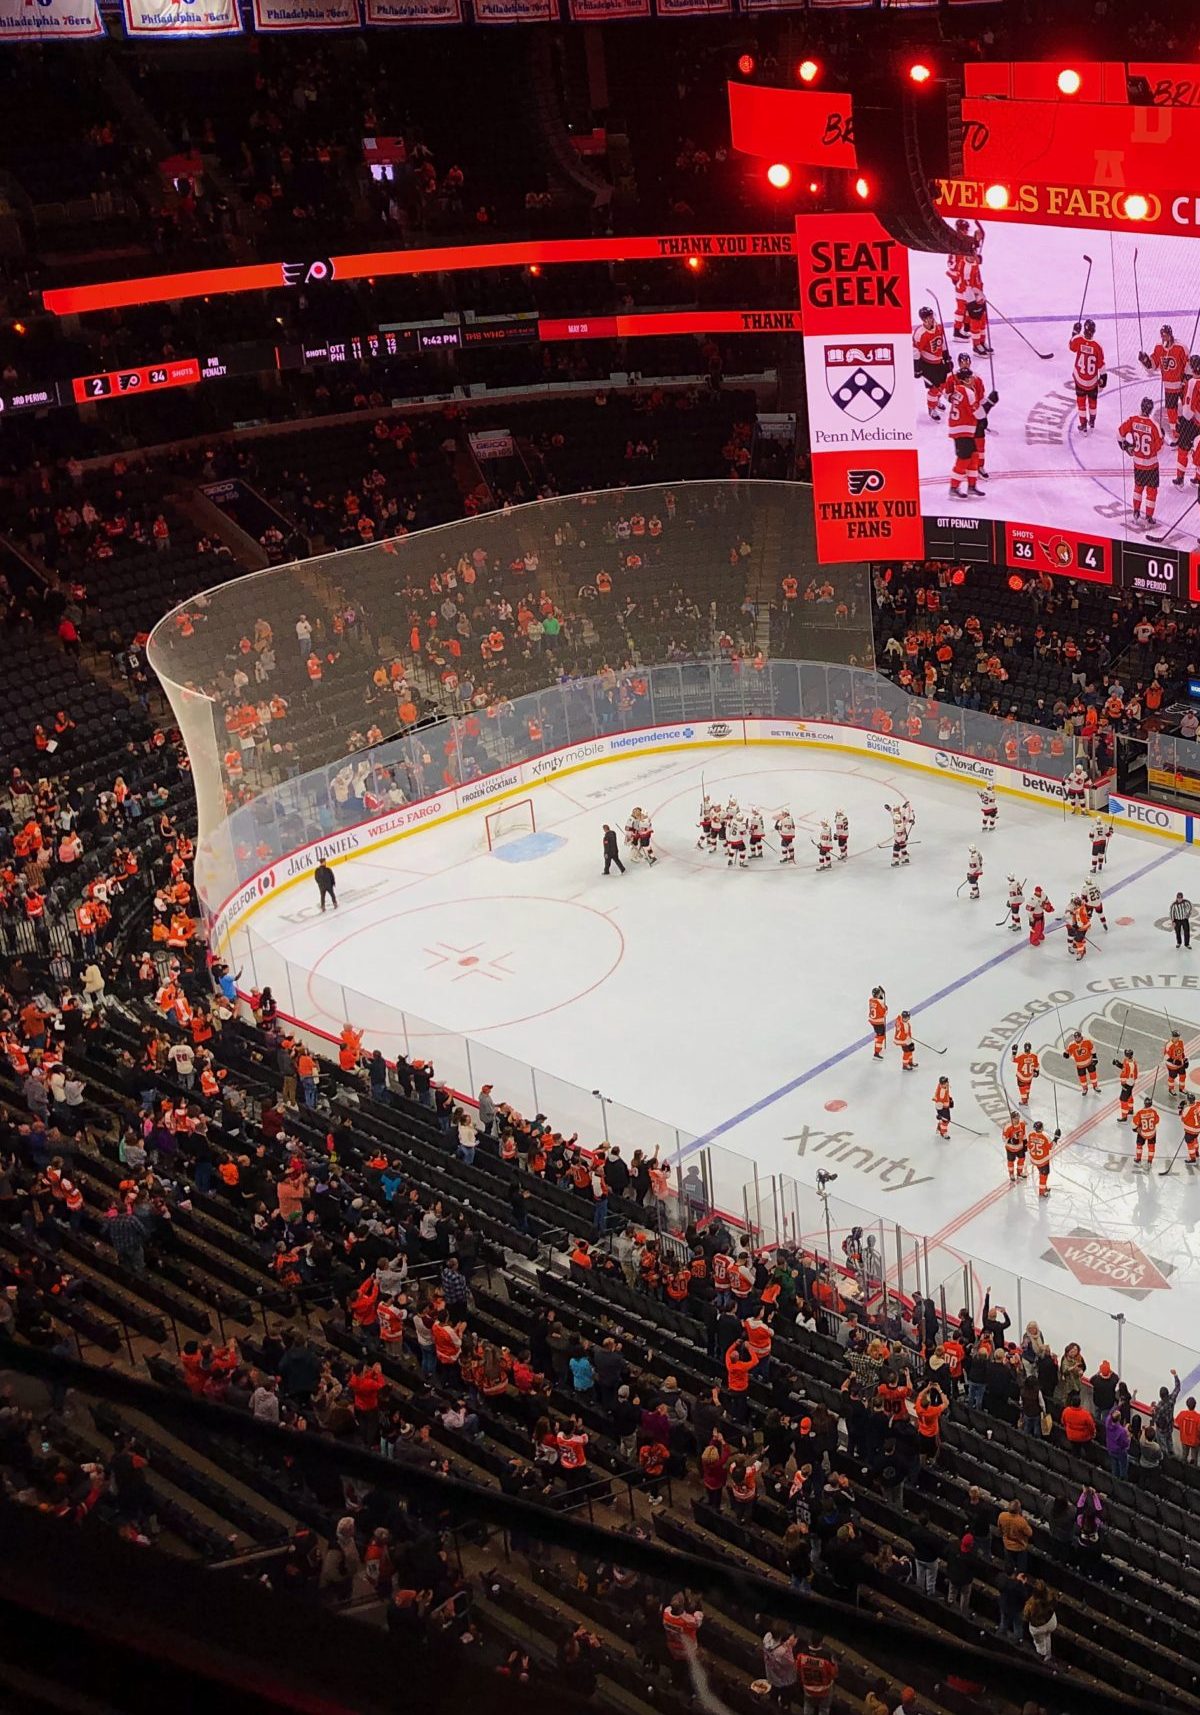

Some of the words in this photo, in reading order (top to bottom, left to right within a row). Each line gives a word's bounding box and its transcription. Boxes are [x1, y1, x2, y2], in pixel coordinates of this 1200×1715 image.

[0, 15, 60, 27] hiladelphia
[62, 15, 92, 26] 76ers
[141, 12, 201, 25] Philadelphia
[204, 12, 230, 22] 76ers
[266, 8, 325, 20] Philadelphia
[657, 238, 712, 256] THANK
[717, 236, 748, 254] YOU
[751, 235, 792, 253] FANS
[810, 239, 897, 274] SEAT
[808, 274, 904, 310] GEEK
[741, 312, 795, 330] THANK
[422, 335, 442, 346] 9:42
[443, 333, 458, 345] PM
[483, 329, 505, 339] WHO
[306, 348, 327, 358] SHOTS
[330, 344, 346, 354] OTT
[351, 342, 361, 350] 11
[368, 339, 379, 349] 13
[386, 338, 397, 346] 12
[330, 352, 346, 363] PHI
[353, 350, 362, 359] 11
[387, 345, 397, 355] 17
[207, 357, 219, 368] PHI
[1078, 352, 1097, 376] 46
[151, 370, 165, 383] 34
[172, 367, 194, 378] SHOTS
[202, 366, 227, 379] PENALTY
[92, 379, 104, 396] 2
[25, 391, 48, 404] PERIOD
[815, 430, 849, 444] Penn
[851, 428, 913, 443] Medicine
[818, 501, 880, 521] THANK
[883, 500, 918, 519] YOU
[847, 519, 893, 540] FANS
[937, 517, 950, 529] OTT
[951, 518, 980, 531] PENALTY
[1012, 529, 1035, 540] SHOTS
[1015, 542, 1033, 559] 36
[1084, 547, 1097, 569] 4
[1147, 559, 1175, 582] 0.0
[1134, 577, 1146, 589] 3RD
[1146, 580, 1168, 593] PERIOD
[610, 730, 681, 750] Independence
[770, 729, 834, 741] BETRIVERS.COM
[866, 733, 900, 748] COMCAST
[866, 741, 901, 756] BUSINESS
[532, 753, 564, 776] xfinity
[565, 742, 605, 763] mobile
[949, 754, 995, 777] NovaCare
[462, 787, 486, 804] FROZEN
[485, 776, 518, 796] COCKTAILS
[1022, 774, 1070, 801] betway
[367, 816, 405, 838] WELLS
[406, 802, 442, 823] FARGO
[1127, 803, 1170, 828] PECO
[287, 854, 313, 876] JACK
[315, 833, 360, 860] DANIEL'S
[228, 886, 257, 920] BELFOR
[1088, 890, 1101, 902] 23
[978, 989, 1076, 1052] FARGO
[1030, 1143, 1044, 1157] 25
[783, 1125, 935, 1193] xfinity
[1063, 1246, 1144, 1287] WATSON
[1083, 1241, 1138, 1270] DIETZ
[1134, 1263, 1147, 1276] &
